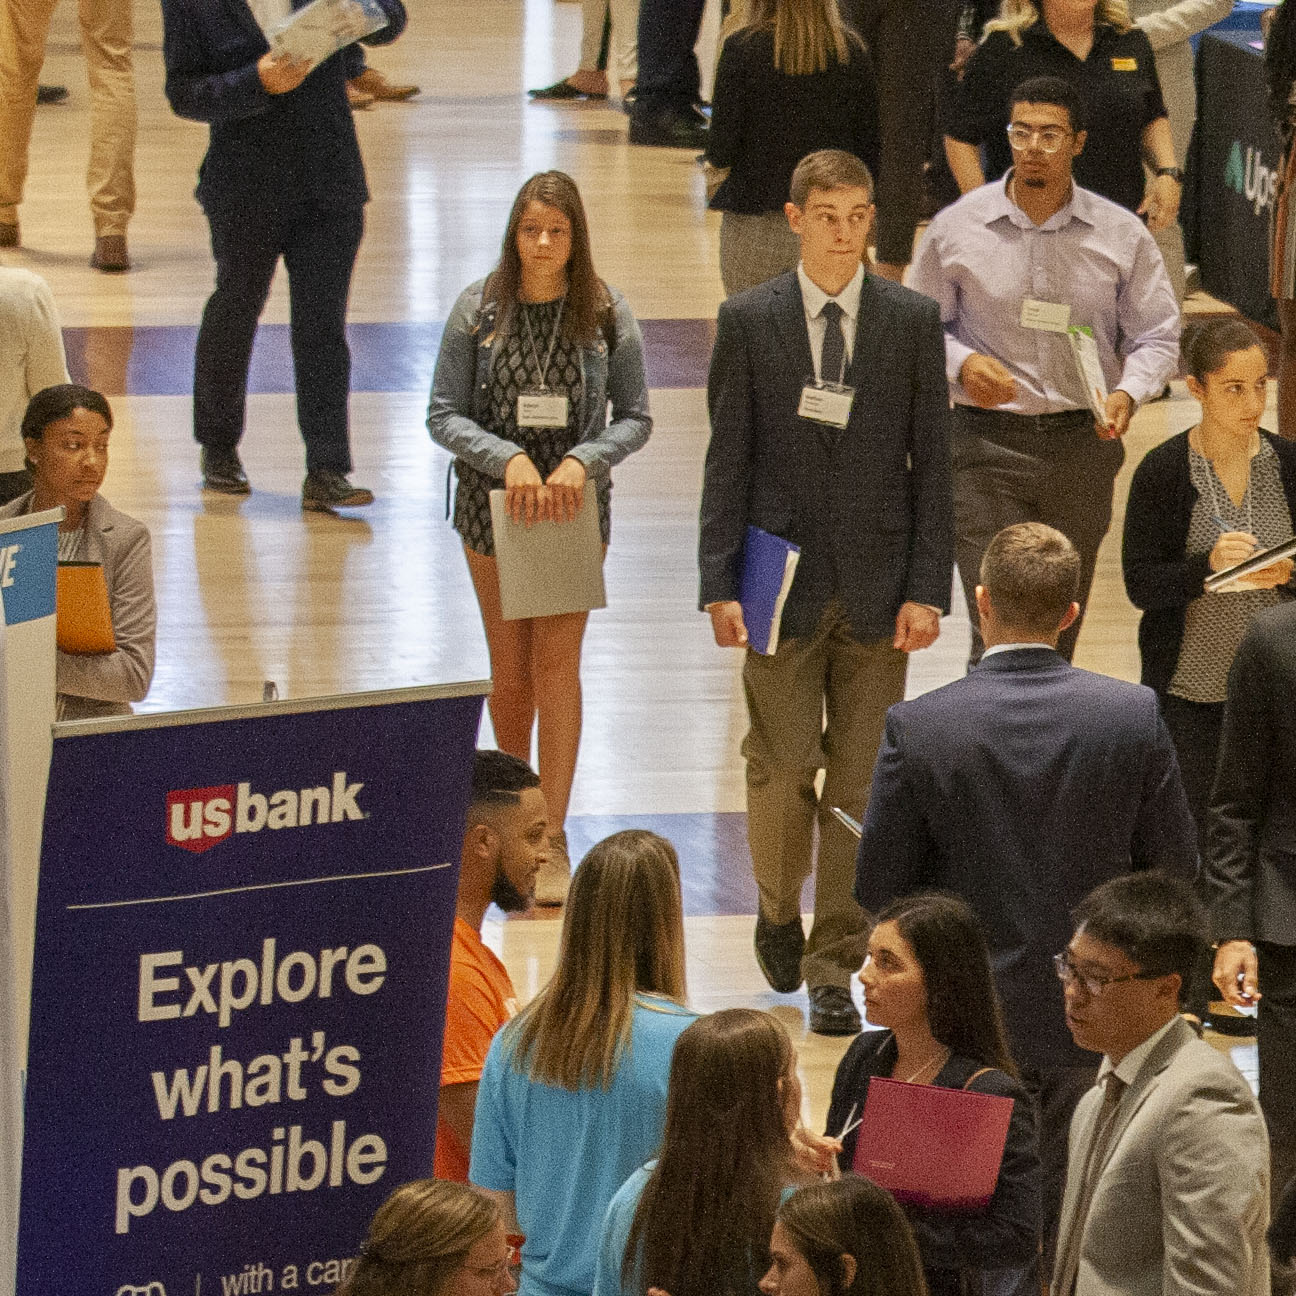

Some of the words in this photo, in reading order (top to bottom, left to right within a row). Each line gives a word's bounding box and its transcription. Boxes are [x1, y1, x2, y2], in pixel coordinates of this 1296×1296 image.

[170, 771, 366, 841] usbank
[138, 938, 387, 1028] Explore
[151, 1031, 362, 1120] what's
[115, 1120, 388, 1234] possible
[281, 1264, 299, 1289] a
[306, 1258, 353, 1285] car
